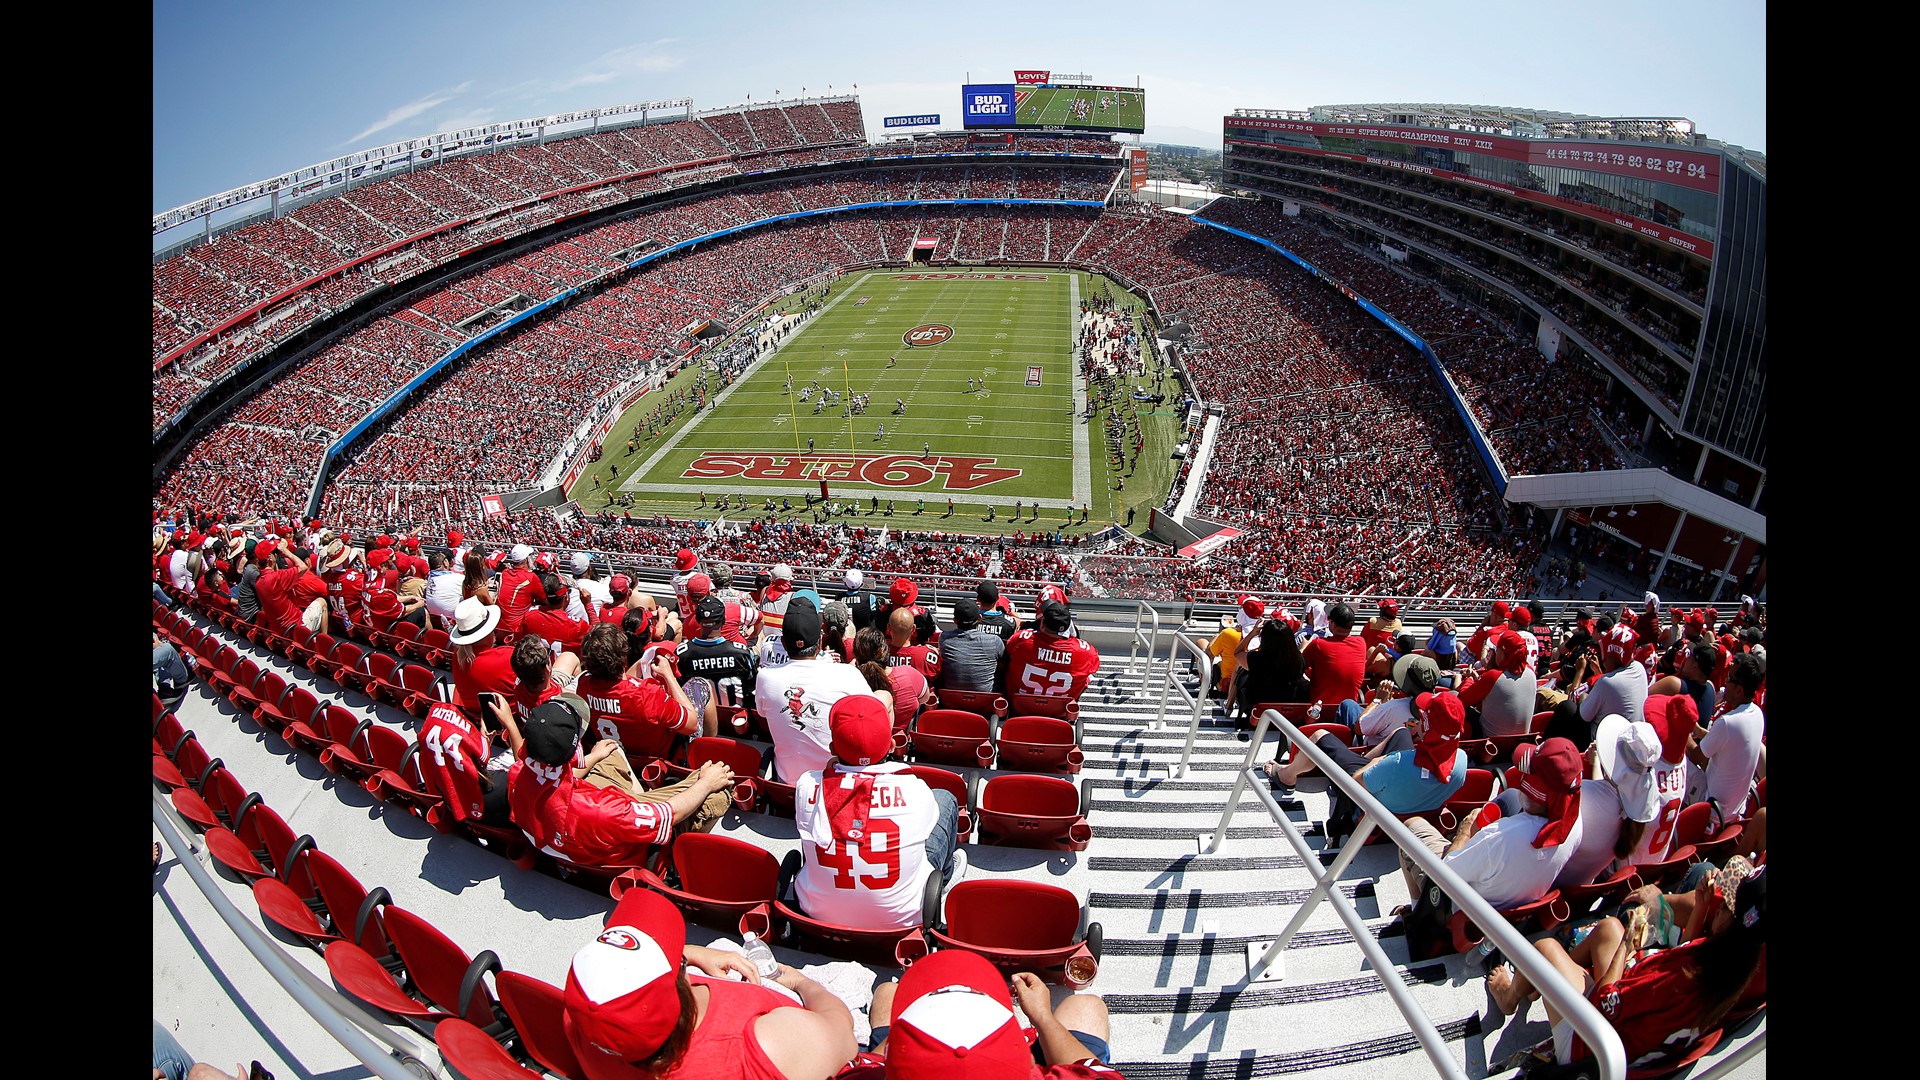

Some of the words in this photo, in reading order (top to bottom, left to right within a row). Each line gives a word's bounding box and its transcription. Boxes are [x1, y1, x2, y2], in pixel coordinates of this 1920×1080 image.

[970, 104, 1008, 114] LIGHT
[974, 96, 1002, 104] BUD
[1380, 130, 1399, 138] BOWL
[1400, 132, 1449, 144] CHAMPIONS
[1454, 137, 1470, 146] XXIV
[1366, 157, 1381, 166] HOME
[1402, 163, 1433, 175] FAITHFUL
[1570, 150, 1580, 160] 70
[1612, 154, 1624, 166] 79
[1628, 155, 1642, 168] 80
[1646, 157, 1662, 171] 82
[1666, 160, 1682, 175] 87
[1688, 163, 1706, 179] 94
[1615, 218, 1633, 229] WALSH
[1641, 226, 1660, 238] McVAY
[1669, 236, 1696, 251] SEIFERT
[680, 452, 1022, 490] 49ERS
[1598, 521, 1620, 535] FRANKS
[692, 657, 735, 670] PEPPERS
[889, 656, 912, 667] RICE
[1037, 648, 1072, 664] WILLIS
[1019, 663, 1073, 696] 52
[587, 694, 621, 714] YOUNG
[431, 706, 471, 733] RATHMAN
[425, 725, 465, 772] 44
[630, 801, 656, 830] 16
[1648, 798, 1681, 854] 8
[815, 818, 900, 890] 49
